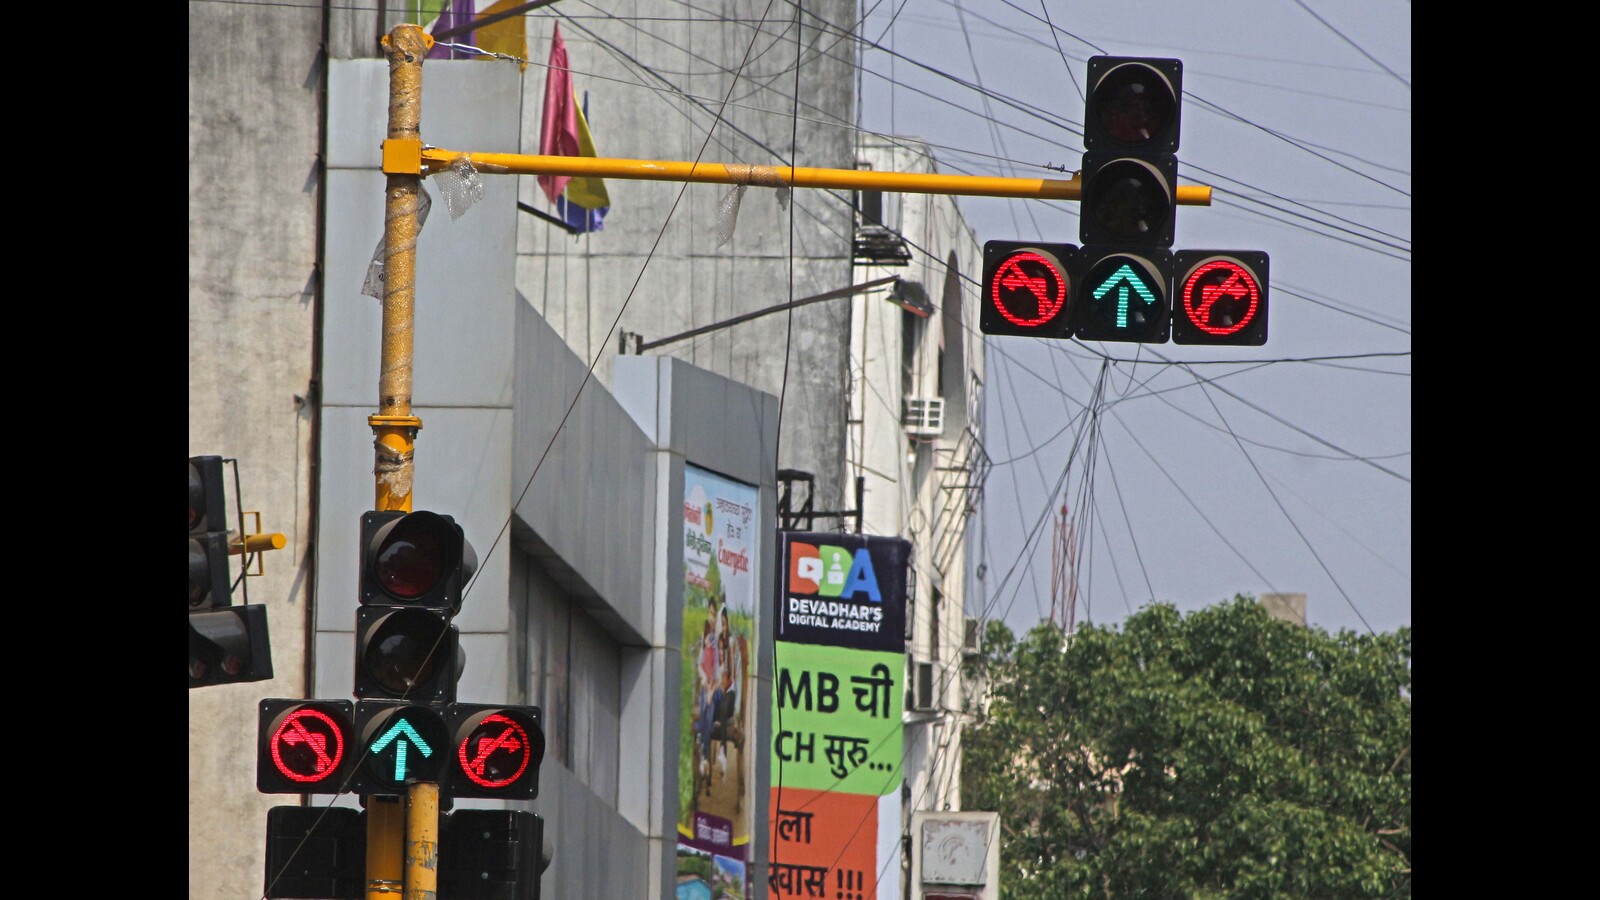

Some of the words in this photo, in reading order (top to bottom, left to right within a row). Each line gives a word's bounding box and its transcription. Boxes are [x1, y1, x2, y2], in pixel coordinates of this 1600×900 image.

[718, 538, 749, 576] Energetic
[788, 613, 829, 628] DIGITAL
[831, 617, 881, 632] ACADEMY
[789, 597, 883, 622] DEVADHAR'S
[850, 663, 894, 719] ची
